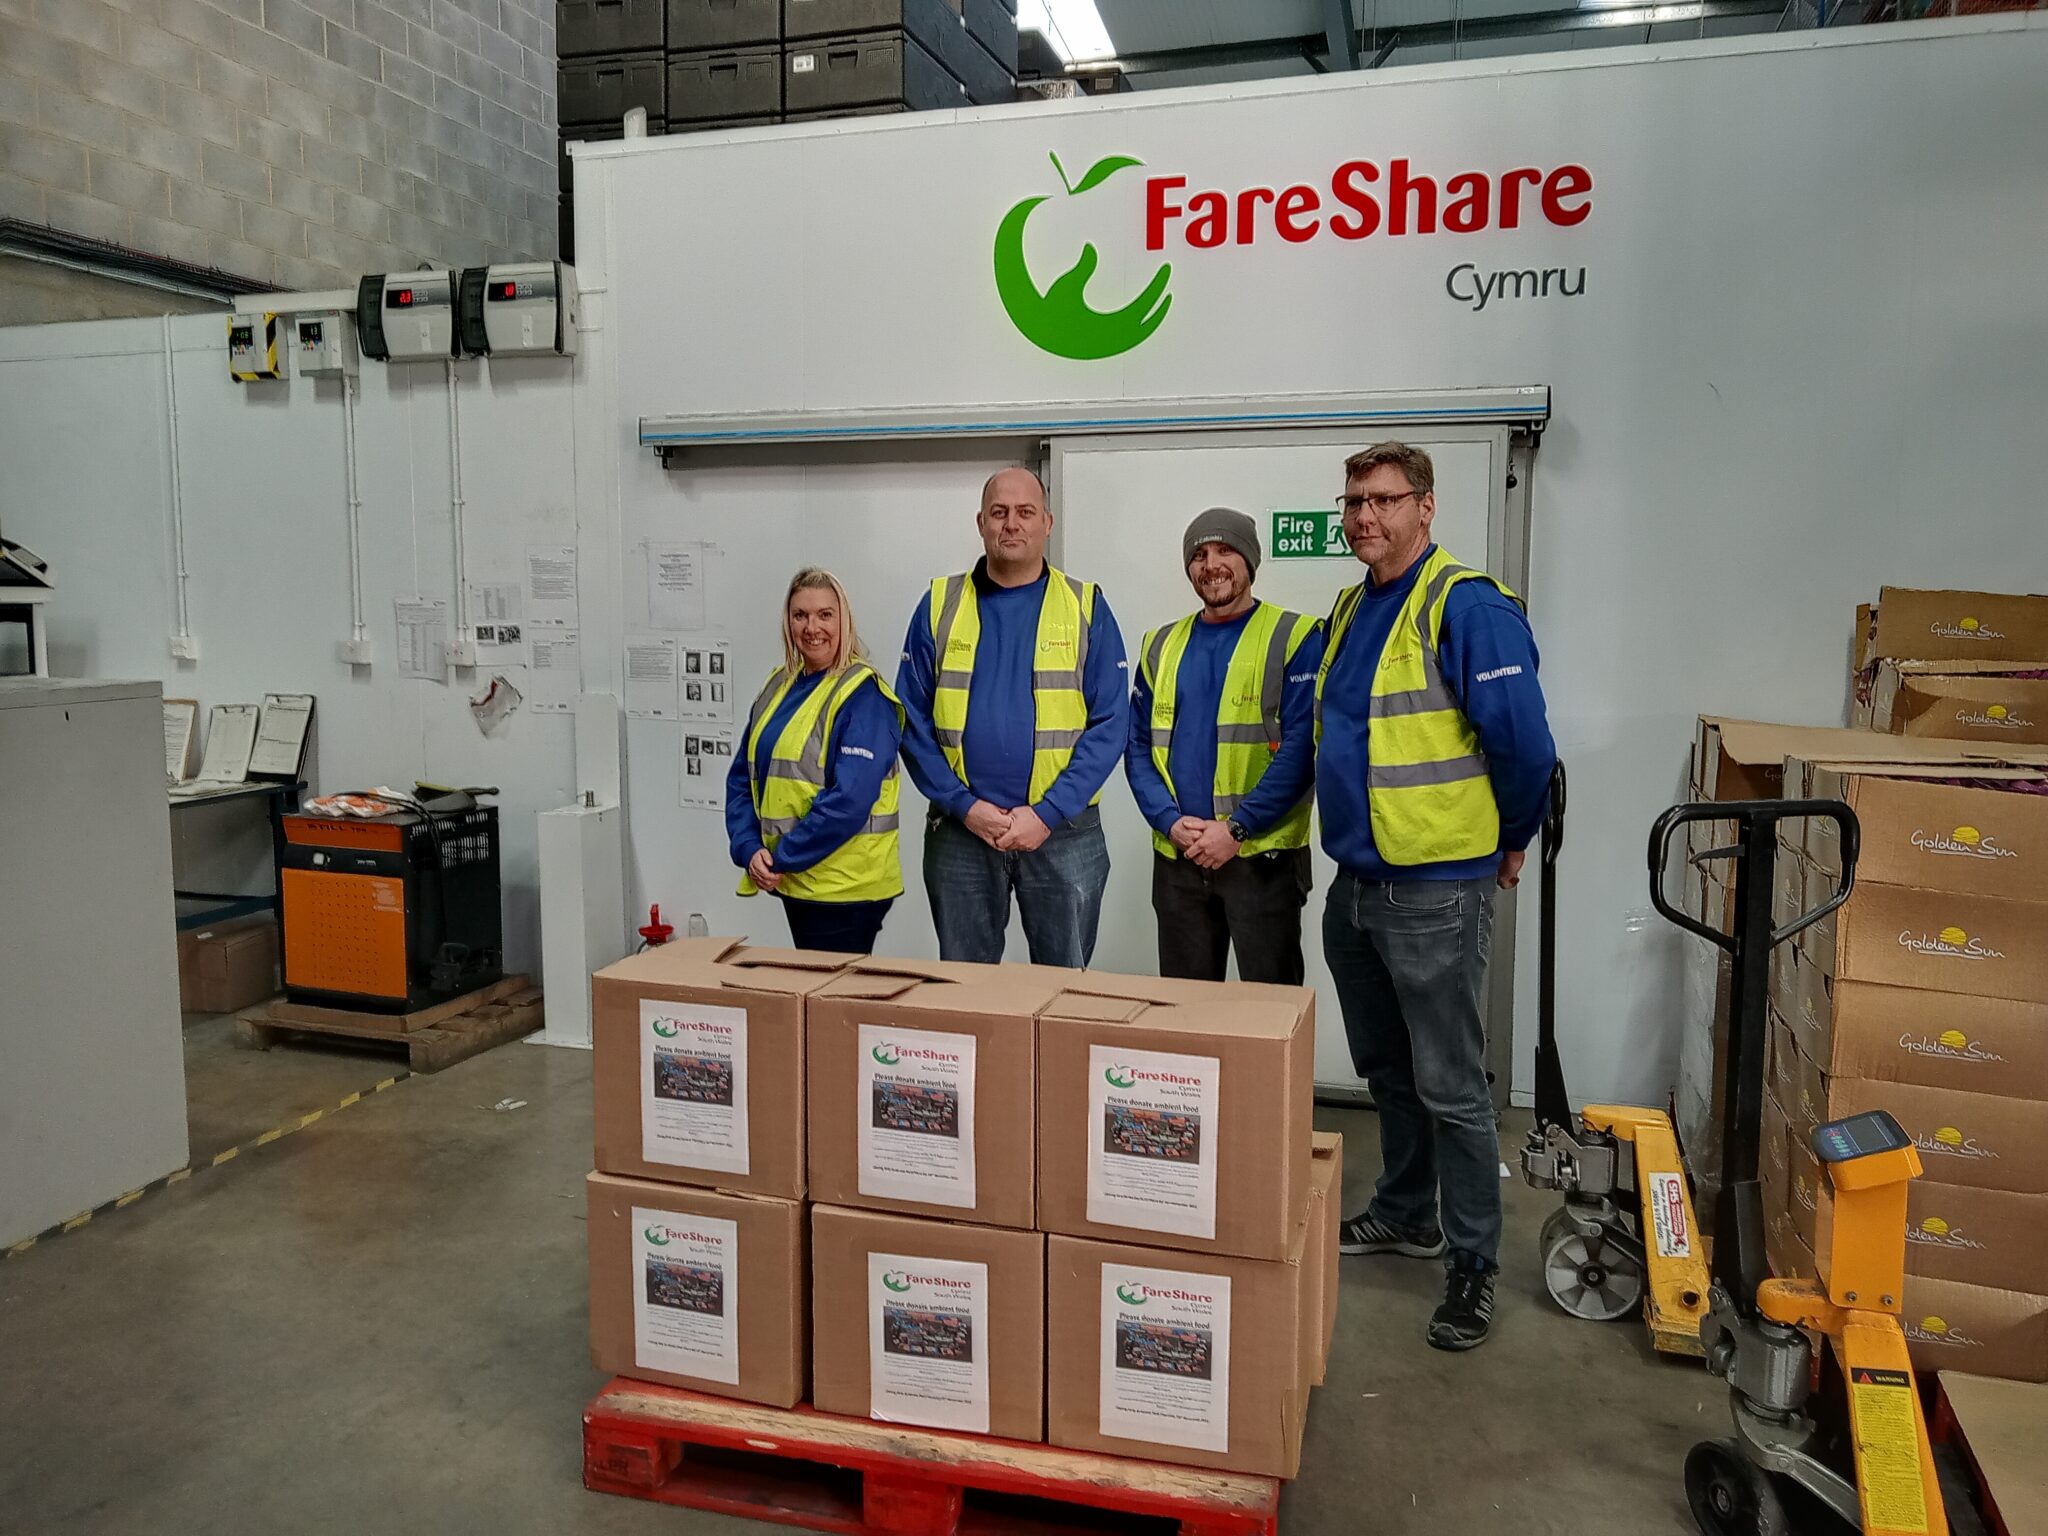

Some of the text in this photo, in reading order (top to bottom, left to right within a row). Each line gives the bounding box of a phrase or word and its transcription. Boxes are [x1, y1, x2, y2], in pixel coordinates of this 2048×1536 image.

[1146, 158, 1592, 251] FareShare
[1446, 263, 1586, 311] Cymru
[1278, 516, 1314, 533] Fire
[1278, 535, 1313, 552] exit
[1931, 622, 2005, 638] Golden Sun
[1476, 665, 1522, 682] VOLUNTEER
[1955, 710, 2034, 726] Golden Sun
[1910, 829, 2018, 857] Golden Sun
[1898, 930, 2006, 958] Golden Sun
[673, 1019, 732, 1034] FareShare
[655, 1045, 673, 1054] Please
[674, 1046, 693, 1056] donate
[718, 1051, 731, 1060] food
[895, 1045, 959, 1062] FareShare
[1899, 1033, 2009, 1062] Golden Sun
[874, 1072, 957, 1090] Please donate ambient food
[1130, 1068, 1201, 1086] FareShare
[1107, 1095, 1199, 1113] Please donate ambient food
[1912, 1133, 2000, 1158] olden Sun
[1668, 1183, 1680, 1203] SHS
[665, 1228, 722, 1245] FareShare
[1905, 1223, 1987, 1249] lden Sun
[905, 1274, 971, 1289] FareShare
[1142, 1286, 1212, 1303] FareShare
[930, 1304, 955, 1313] ambient
[956, 1305, 970, 1314] food
[1119, 1312, 1210, 1329] Please donate ambient food
[1904, 1322, 1984, 1346] lden Sun
[1875, 1376, 1905, 1385] WARNING
